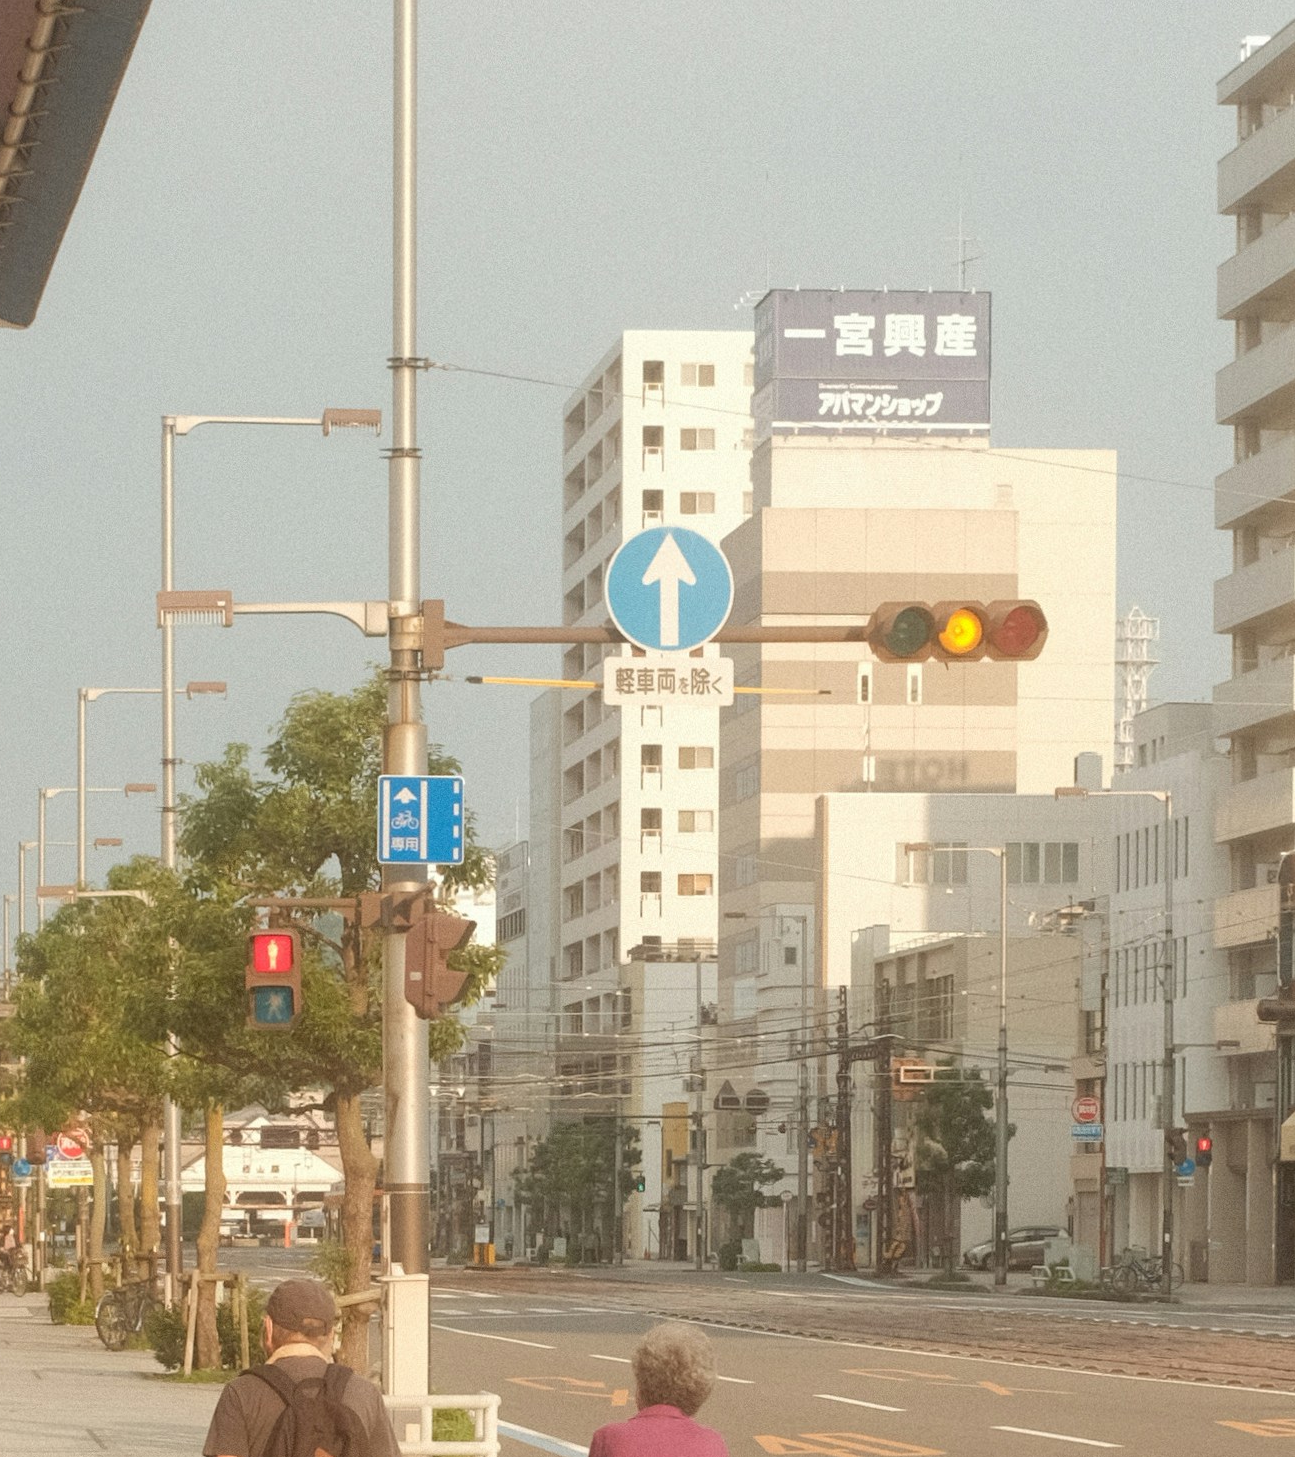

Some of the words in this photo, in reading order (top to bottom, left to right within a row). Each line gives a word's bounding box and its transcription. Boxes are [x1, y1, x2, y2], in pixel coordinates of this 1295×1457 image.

[784, 313, 977, 356] 一宮興産
[818, 391, 943, 416] アパマンショップ
[615, 667, 722, 695] 軽車両を除く
[391, 837, 418, 851] 専用
